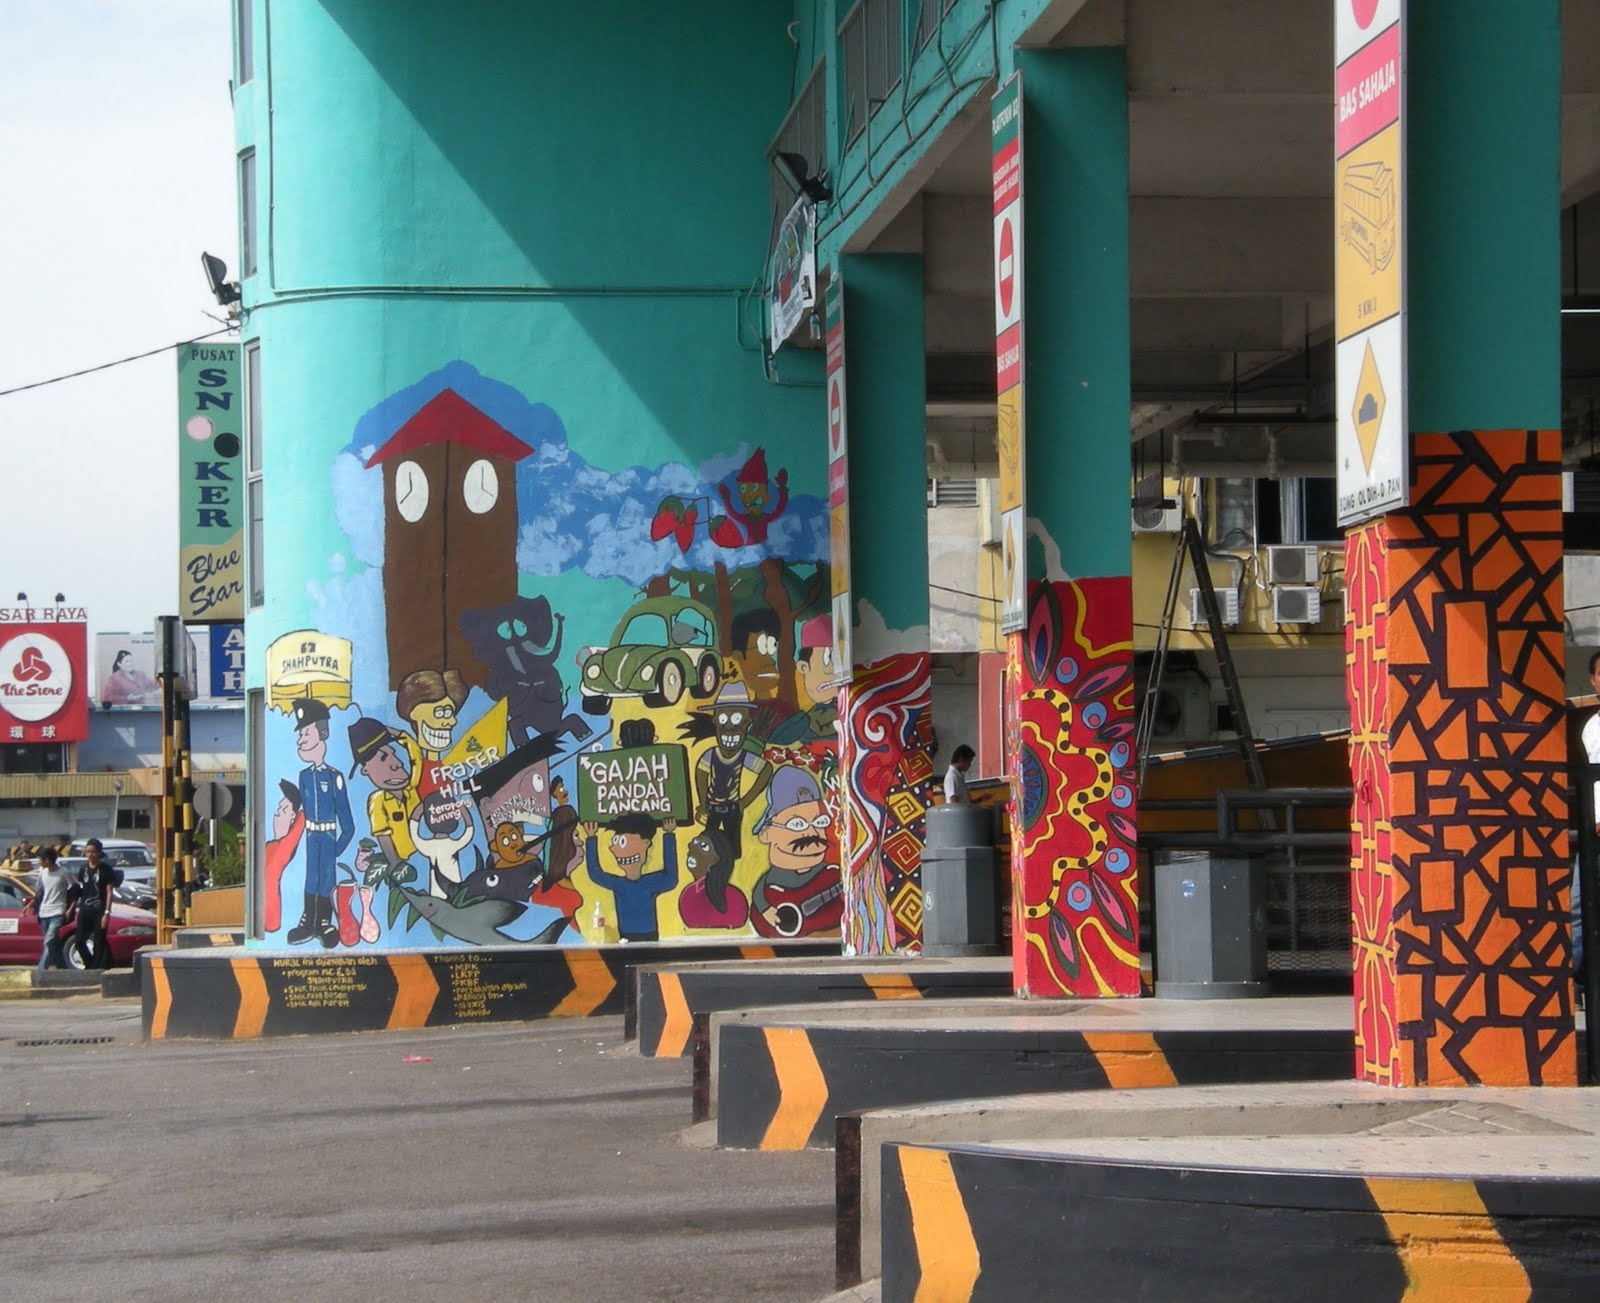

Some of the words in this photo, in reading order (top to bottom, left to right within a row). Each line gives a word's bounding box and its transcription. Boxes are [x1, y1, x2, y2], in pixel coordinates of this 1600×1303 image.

[1340, 86, 1357, 123] BAS
[1359, 59, 1396, 109] SAHAJA
[191, 350, 236, 361] PUSAT
[187, 550, 241, 584] Blue
[189, 581, 244, 616] Star
[0, 608, 36, 621] SAR
[43, 607, 87, 620] RAYA
[282, 655, 339, 674] SHAHPUTRA
[25, 683, 63, 696] Store
[590, 753, 669, 783] GAJAH
[440, 778, 482, 798] HILL
[597, 777, 665, 801] PANDAI
[597, 798, 671, 814] LANCANG
[430, 808, 461, 824] burung
